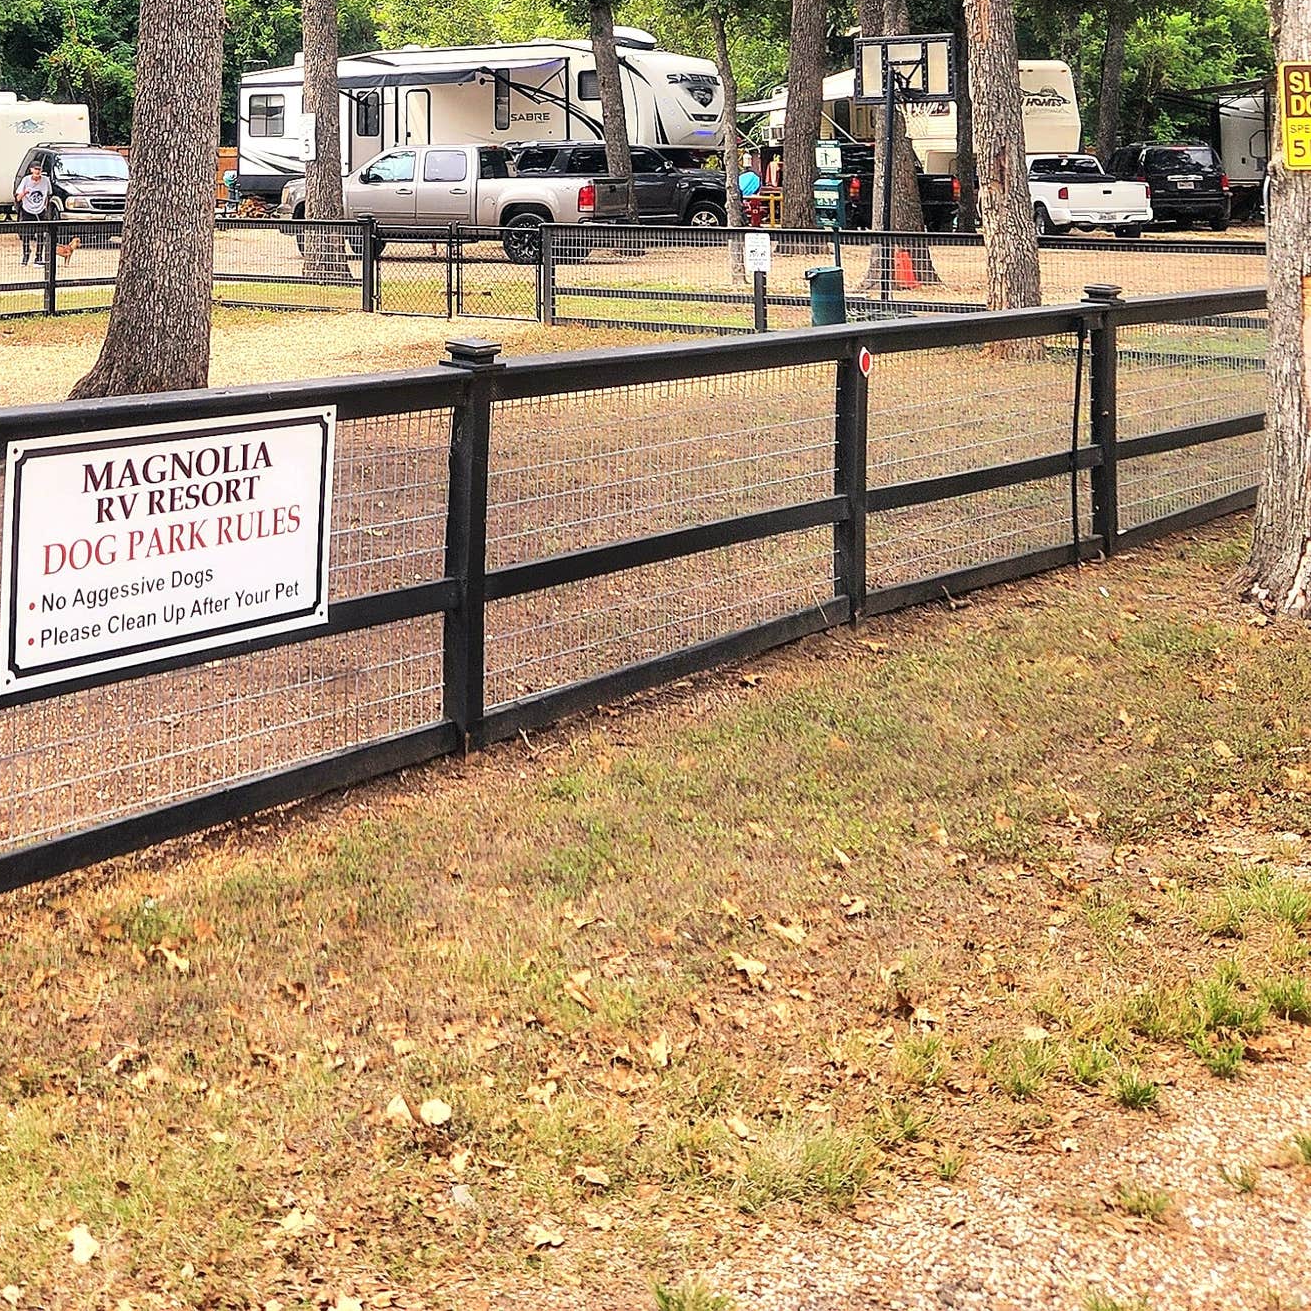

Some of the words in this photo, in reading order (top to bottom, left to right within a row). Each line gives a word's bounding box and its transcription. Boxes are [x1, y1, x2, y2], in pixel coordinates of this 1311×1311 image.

[510, 112, 550, 122] SABRE
[1294, 139, 1306, 158] 5
[81, 441, 273, 493] MAGNOLIA
[95, 493, 141, 524] RV
[146, 475, 261, 517] RESORT
[42, 534, 117, 576] DOG
[126, 519, 209, 561] PARK
[216, 504, 301, 546] RULES
[41, 592, 67, 613] No
[72, 575, 165, 609] Aggessive
[171, 566, 214, 590] Dogs
[40, 623, 101, 649] Please
[107, 613, 157, 635] Clean
[163, 604, 186, 627] Up
[190, 594, 230, 619] After
[234, 587, 270, 608] Your
[275, 580, 300, 601] Pet
